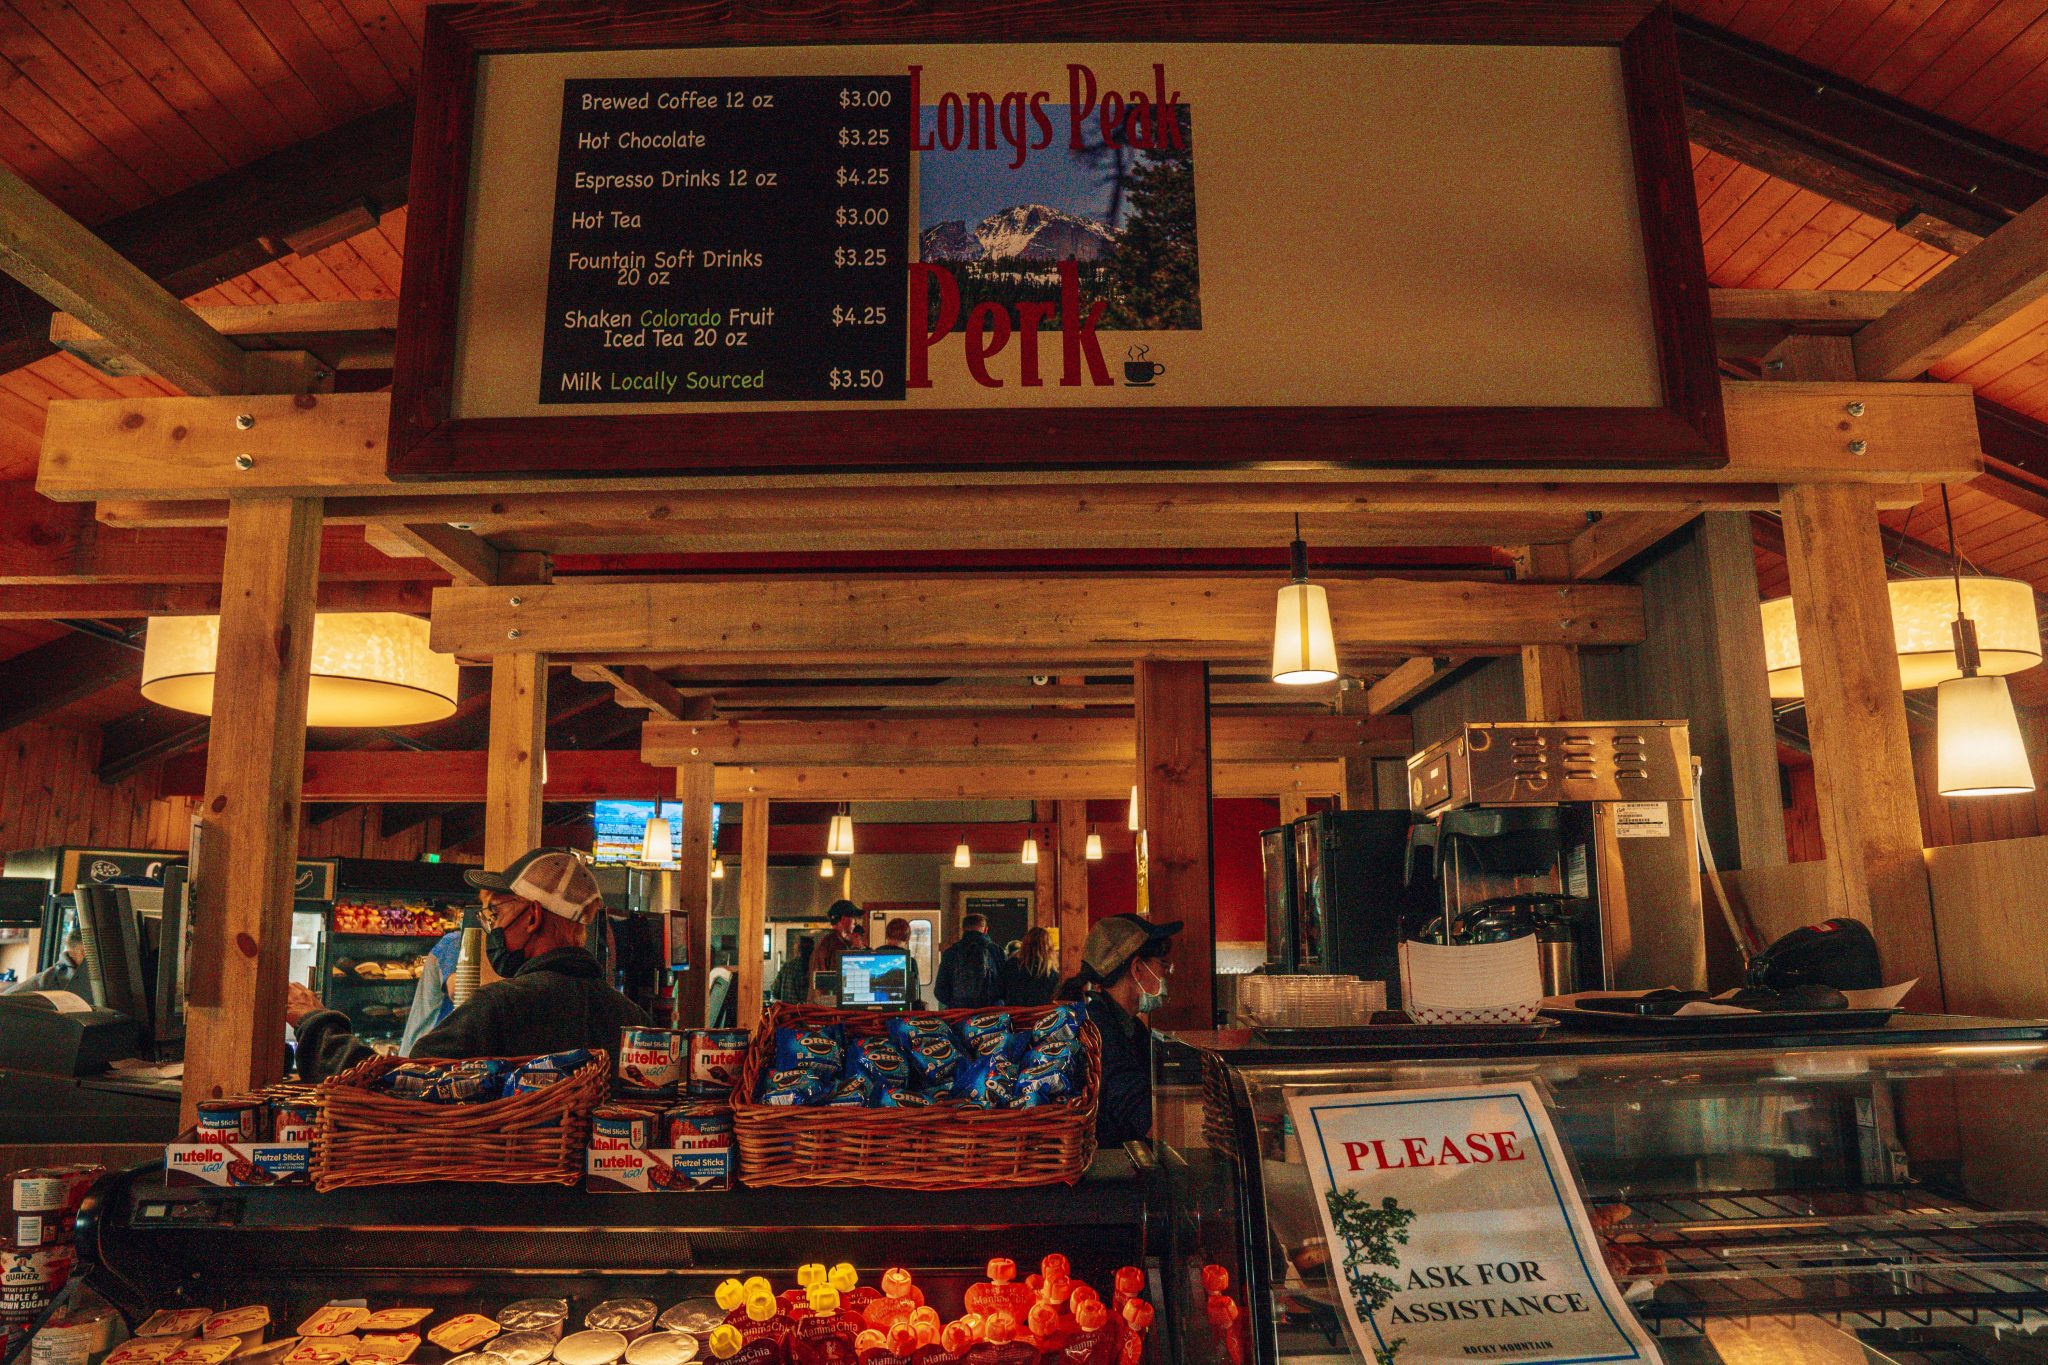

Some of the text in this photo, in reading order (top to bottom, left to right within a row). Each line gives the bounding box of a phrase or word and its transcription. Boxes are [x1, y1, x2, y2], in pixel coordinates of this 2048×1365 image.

[581, 90, 891, 110] Brewed Coffee 12 oz $3.00
[908, 63, 1185, 169] Longs Peak
[578, 129, 889, 149] Hot Chocolate $3.25
[575, 166, 889, 193] Espresso Drinks 12 oz $4.25
[572, 206, 889, 229] Hot Tea $3.00
[569, 247, 887, 270] Fountain Soft Drinks $3.25
[617, 269, 670, 286] 20 oz
[564, 305, 887, 329] Shaken Colorado Fruit $4.25
[906, 260, 1115, 388] Perk
[603, 329, 748, 347] Iced Tea 20 oz
[561, 367, 883, 394] Milk Locally Sourced $3.50
[801, 1038, 836, 1046] OREO
[621, 1051, 668, 1065] nutella
[701, 1050, 745, 1065] nutell
[868, 1054, 903, 1062] OREO
[199, 1130, 238, 1144] utella
[174, 1149, 222, 1162] nutella
[254, 1153, 304, 1162] Pretzel Sticks
[1341, 1131, 1525, 1171] PLEASE
[594, 1155, 642, 1168] nutella
[674, 1158, 724, 1167] Pretzel Sticks
[6, 1273, 39, 1281] QUAKER
[1407, 1261, 1547, 1290] ASK FOR
[4, 1292, 39, 1302] MAPLE &
[20, 1299, 50, 1310] SUGAR
[1391, 1293, 1590, 1325] ASSISTANCE
[799, 1321, 858, 1340] MammaChia
[1463, 1341, 1553, 1354] ROCKY MOUNTAIN
